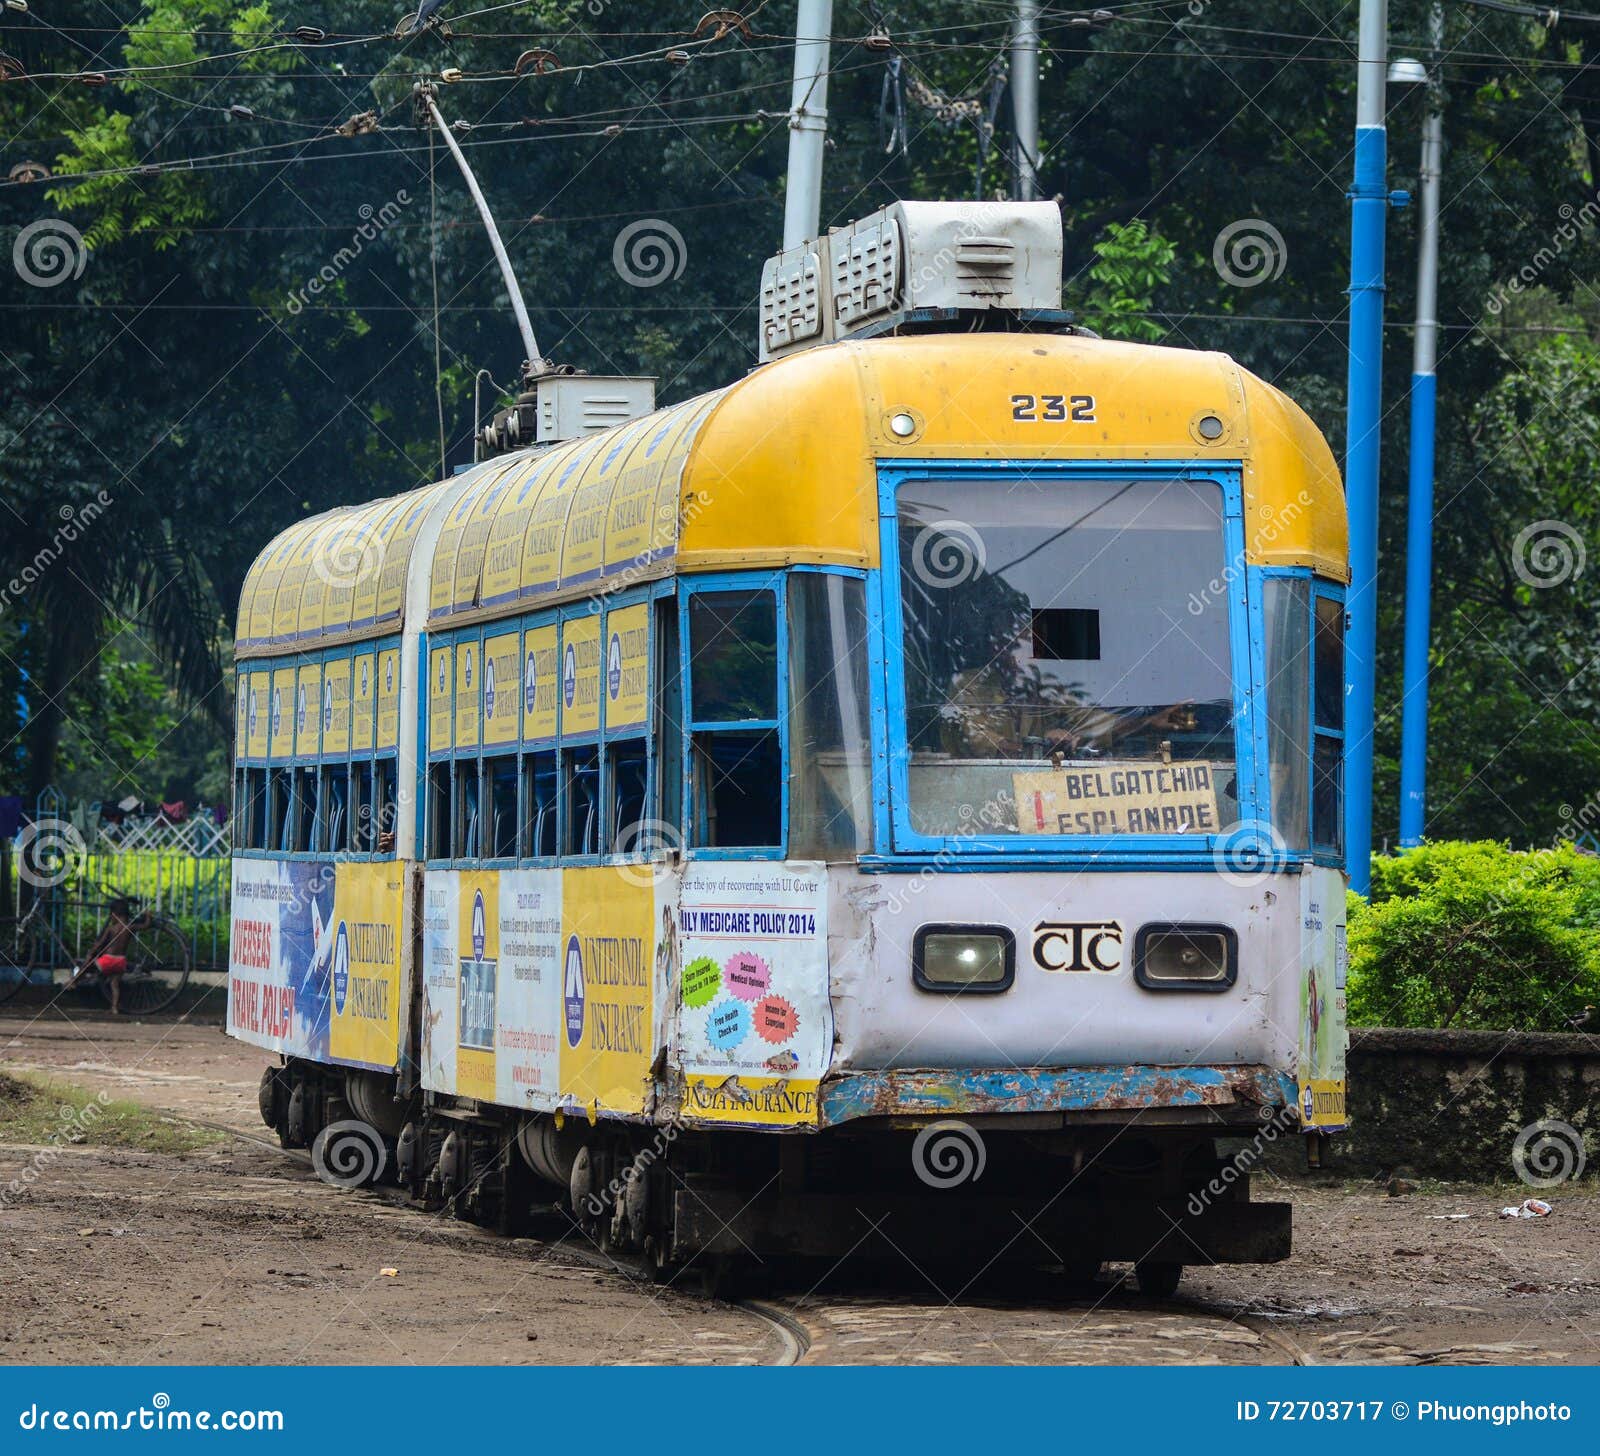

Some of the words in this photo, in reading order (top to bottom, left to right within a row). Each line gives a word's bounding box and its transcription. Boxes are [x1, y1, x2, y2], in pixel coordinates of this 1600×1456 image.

[1011, 394, 1096, 423] 232
[1066, 766, 1210, 800] BELGATCHIA
[694, 878, 704, 890] the
[706, 879, 716, 894] joy
[718, 876, 727, 890] of
[727, 878, 764, 895] recovering
[765, 877, 780, 891] with
[793, 879, 818, 893] Cover
[233, 919, 272, 970] OVERSEAS
[700, 912, 750, 933] MEDICARE
[753, 913, 786, 934] POLICY
[788, 914, 816, 934] 2014
[1032, 920, 1122, 972] CTC
[585, 937, 620, 985] UNITED
[731, 973, 748, 985] Medical
[232, 977, 259, 1033] TRAVEL
[261, 984, 296, 1040] POLICY
[460, 976, 494, 1031] Platinum
[591, 1002, 645, 1053] INSURANCE
